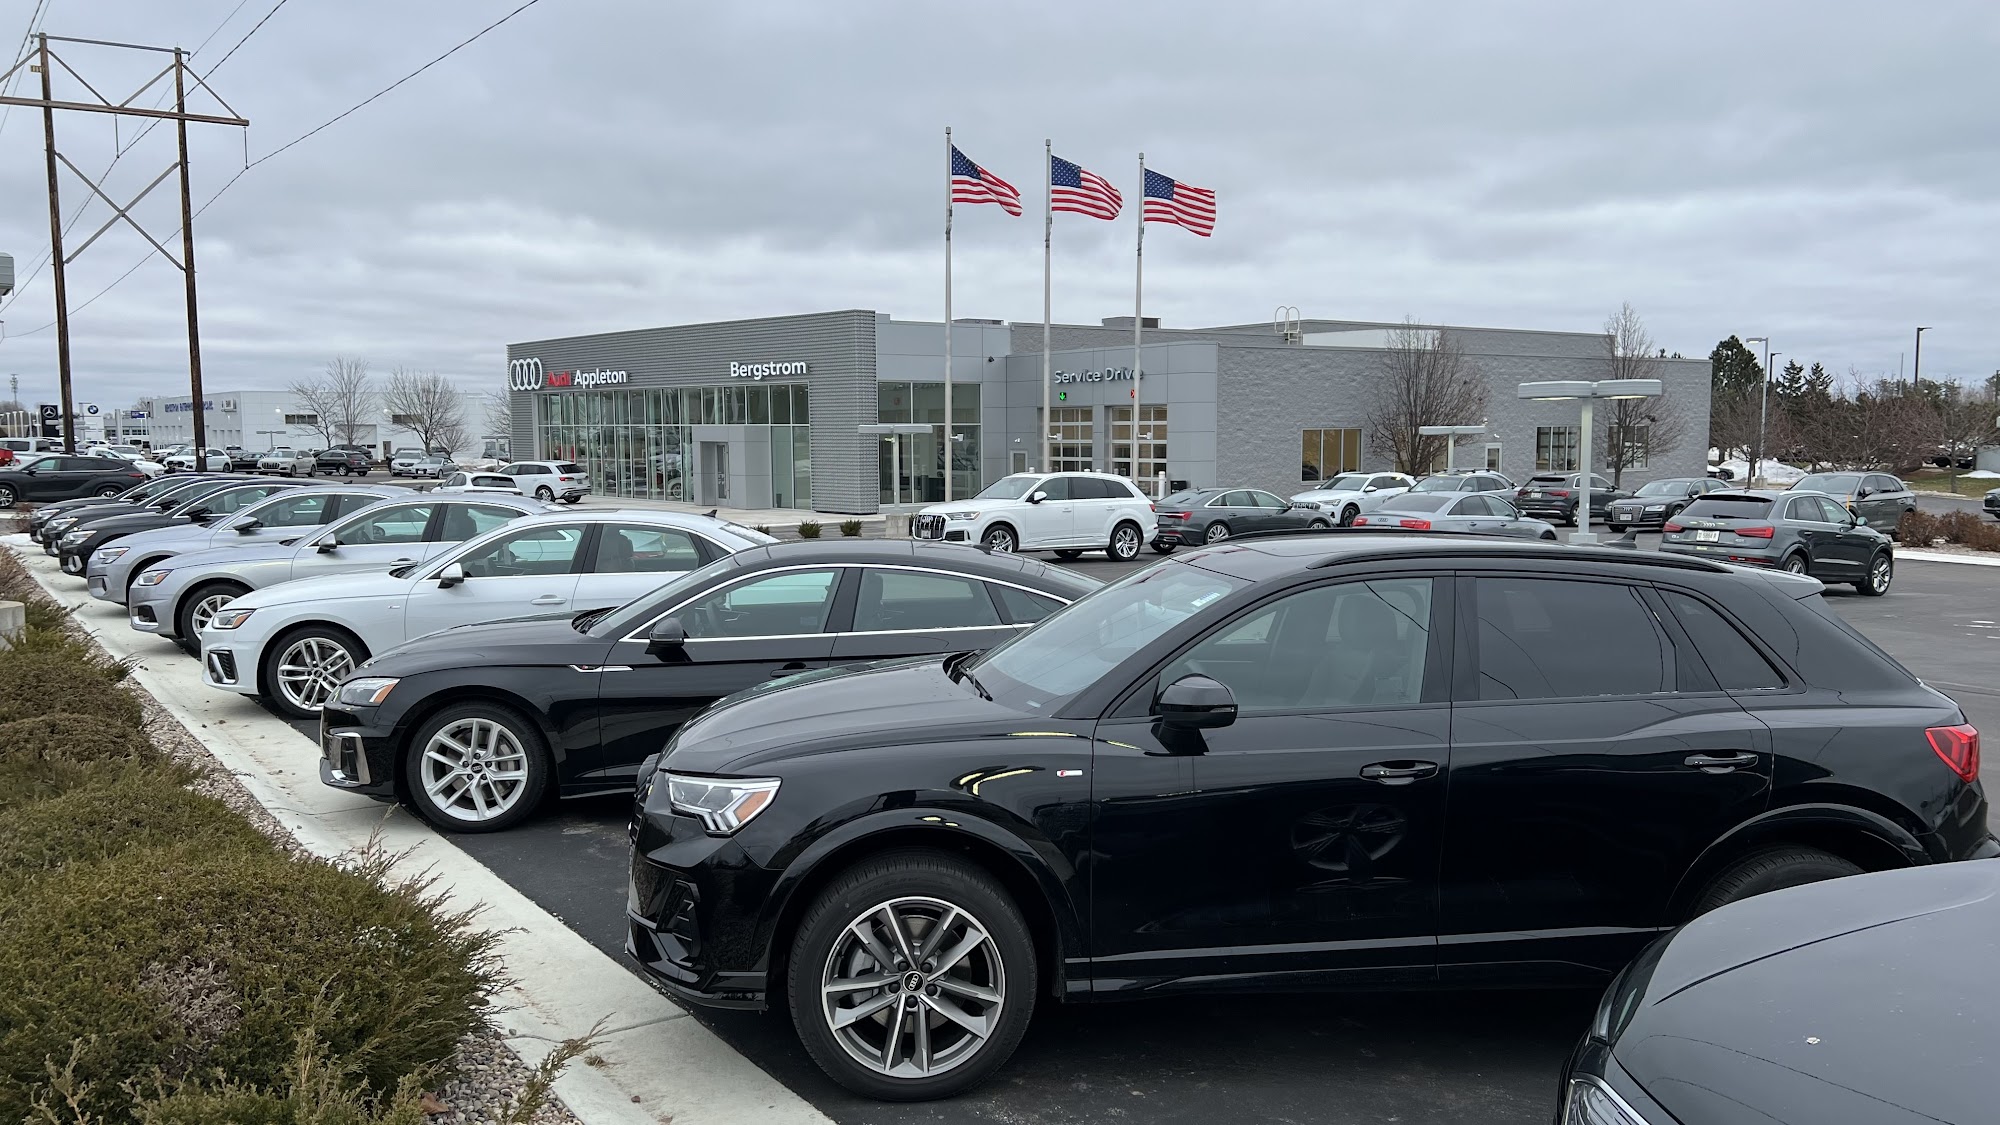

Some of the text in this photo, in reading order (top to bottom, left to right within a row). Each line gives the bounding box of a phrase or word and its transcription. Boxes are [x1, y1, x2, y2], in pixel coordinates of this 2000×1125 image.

[547, 367, 627, 389] Audi Appleton
[730, 361, 807, 380] Bergstrom
[1054, 369, 1101, 384] Service
